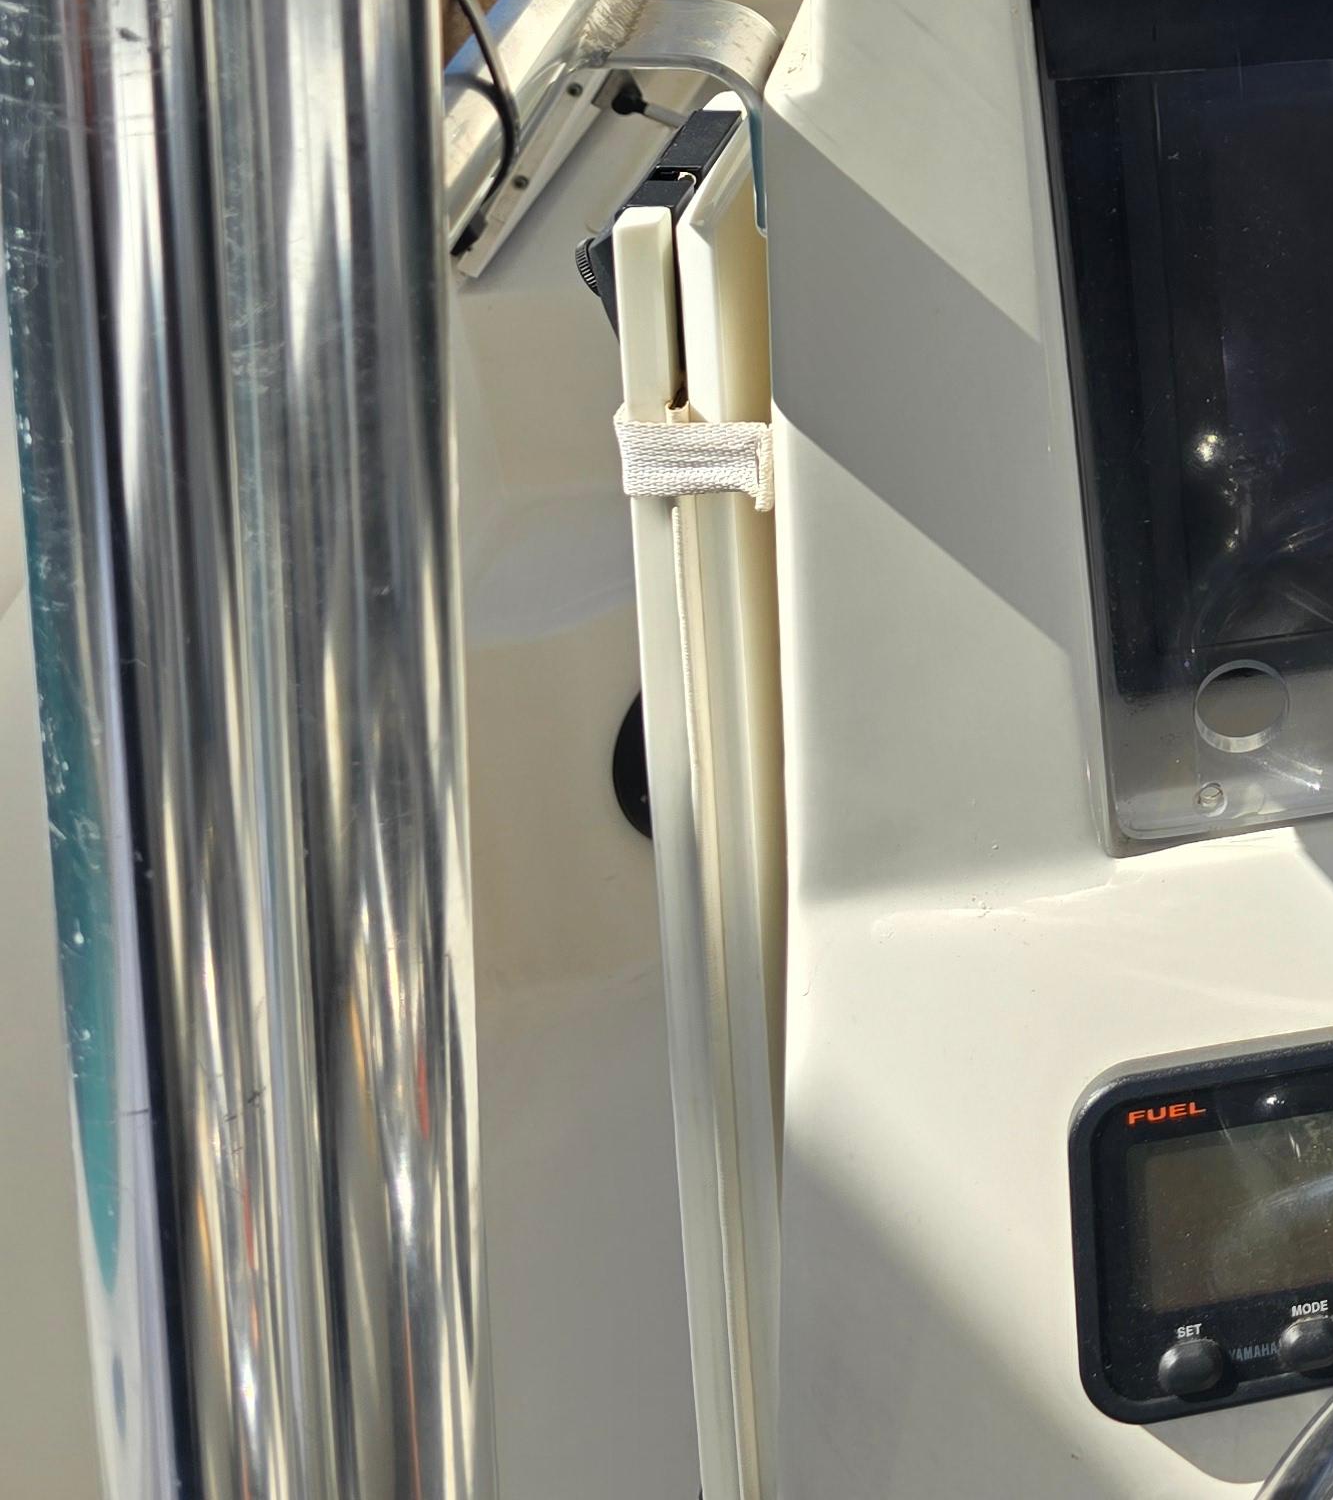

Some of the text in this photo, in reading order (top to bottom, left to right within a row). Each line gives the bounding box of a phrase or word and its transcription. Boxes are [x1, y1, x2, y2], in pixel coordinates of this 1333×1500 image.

[1126, 1101, 1207, 1125] FUEL
[1291, 1299, 1329, 1318] MODE
[1176, 1322, 1203, 1339] SET
